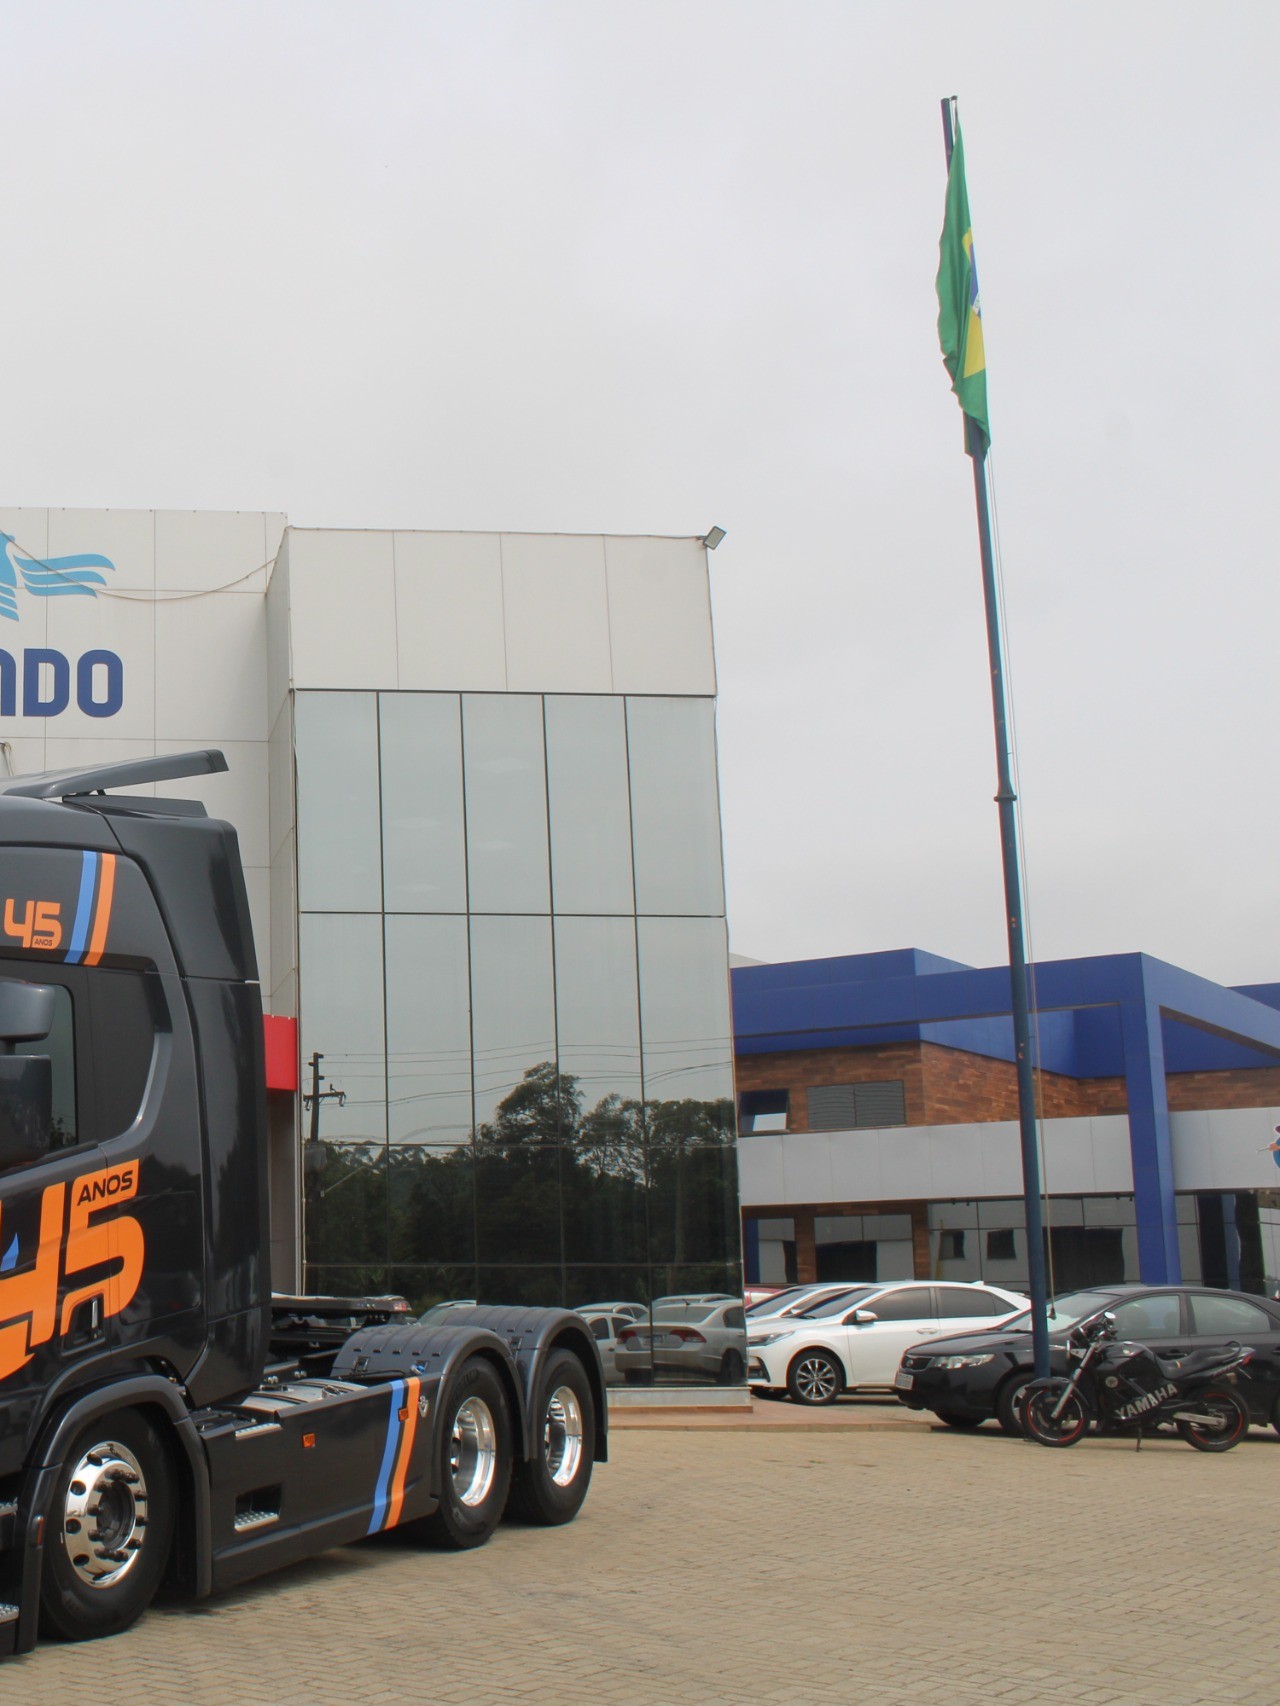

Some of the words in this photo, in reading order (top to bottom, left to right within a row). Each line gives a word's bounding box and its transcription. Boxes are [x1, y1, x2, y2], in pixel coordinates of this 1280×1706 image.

[3, 898, 62, 950] 45
[34, 938, 53, 947] ANOS
[76, 1169, 134, 1207] ANOS
[1114, 1383, 1179, 1421] YAMAHA
